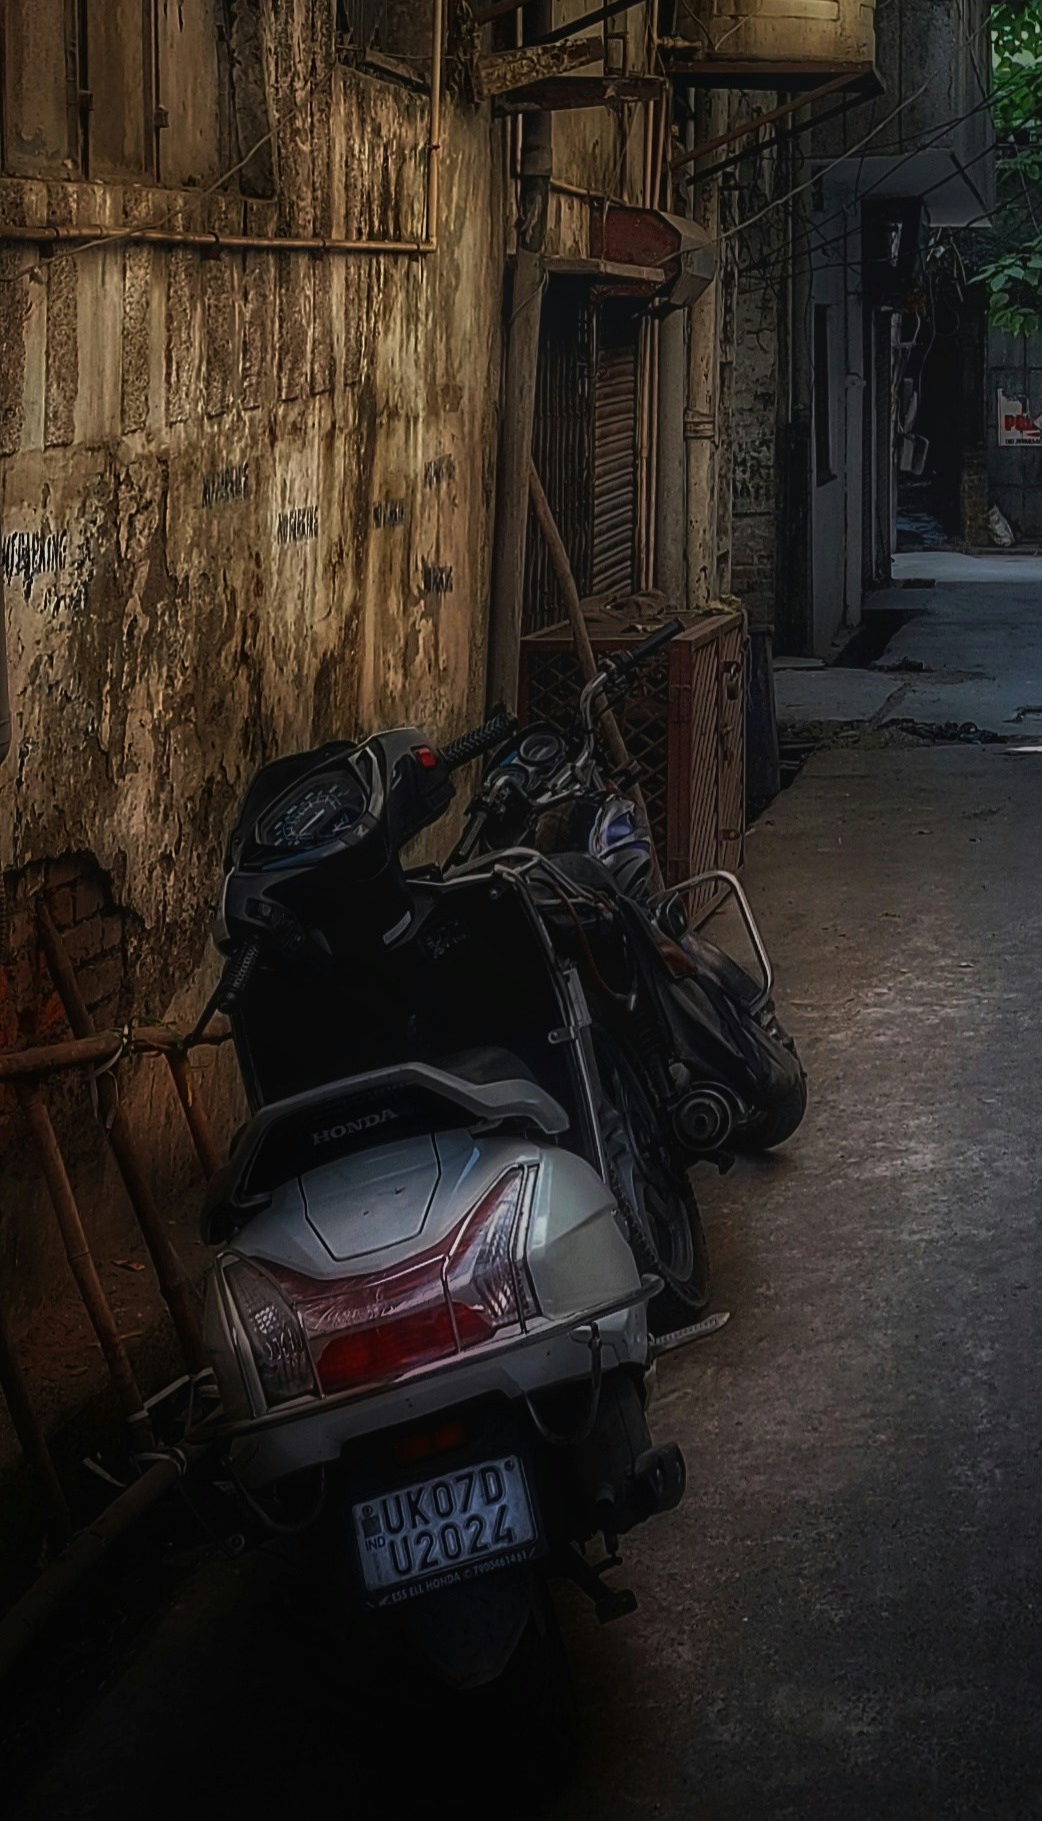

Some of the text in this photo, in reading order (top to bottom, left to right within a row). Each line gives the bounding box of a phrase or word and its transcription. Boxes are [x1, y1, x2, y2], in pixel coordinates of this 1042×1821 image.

[311, 1108, 399, 1146] HONDA
[382, 1465, 504, 1534] UK07D
[365, 1535, 386, 1551] IND
[389, 1504, 514, 1575] U2024
[426, 1572, 462, 1592] HONDA
